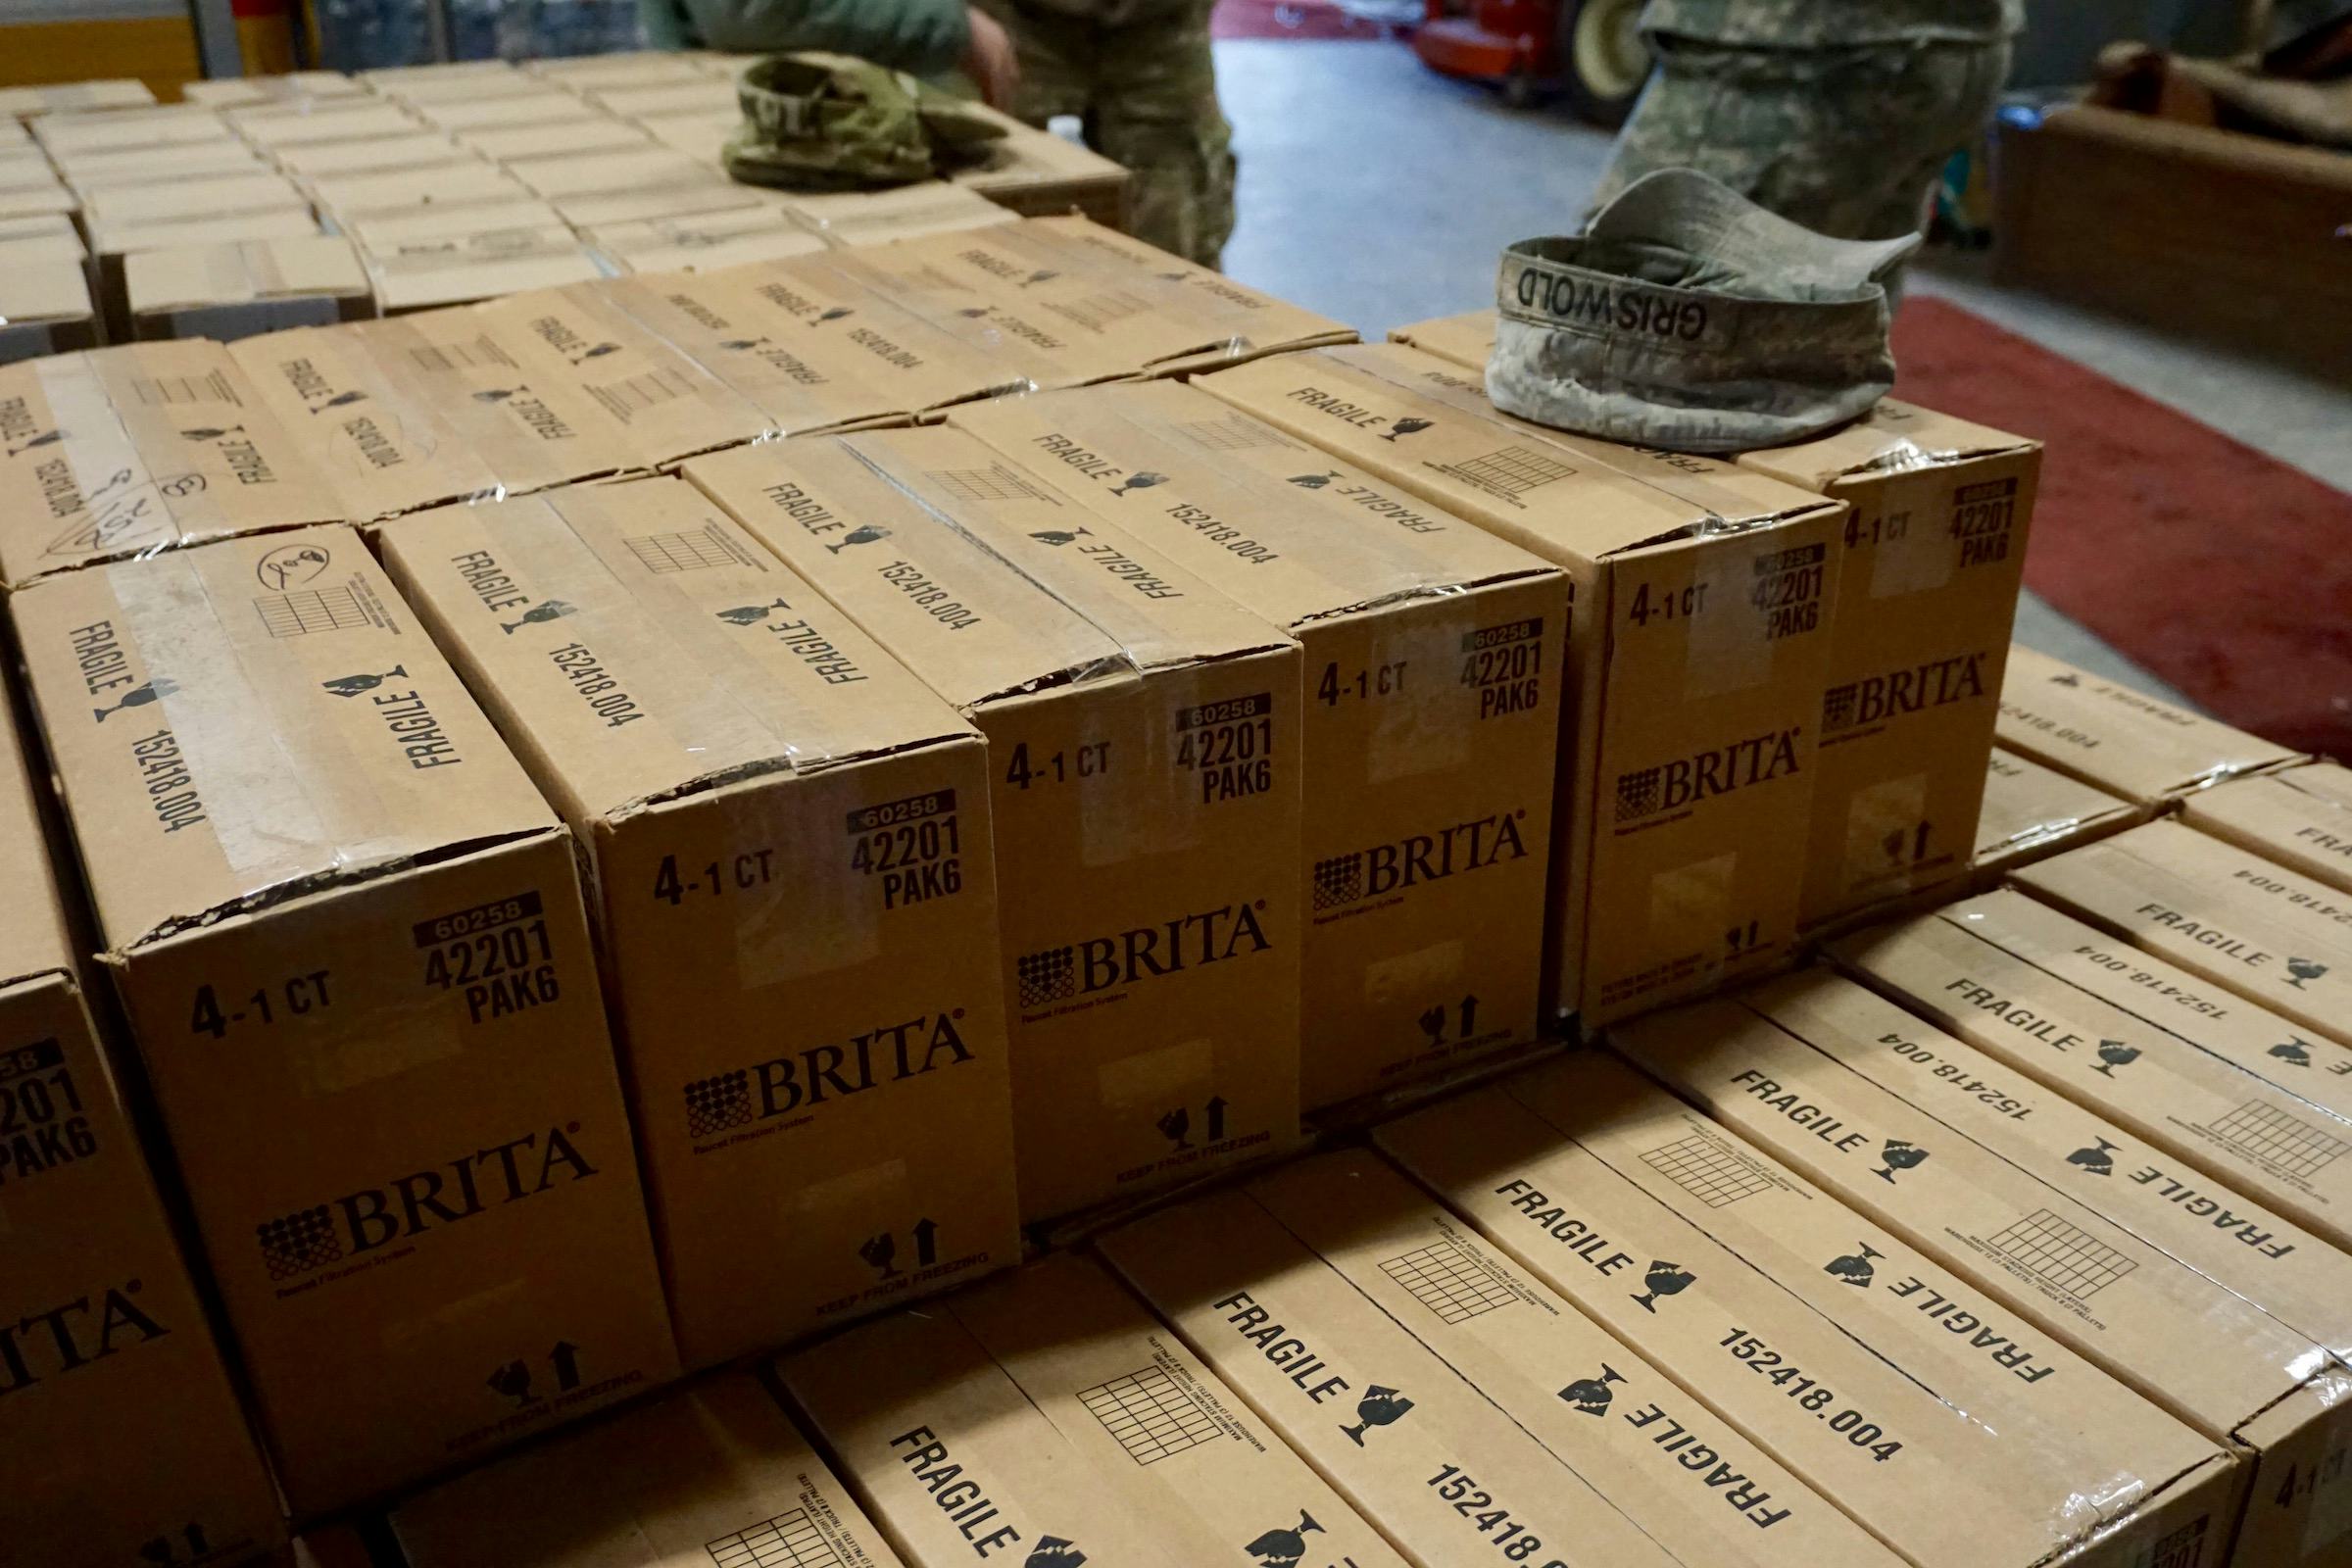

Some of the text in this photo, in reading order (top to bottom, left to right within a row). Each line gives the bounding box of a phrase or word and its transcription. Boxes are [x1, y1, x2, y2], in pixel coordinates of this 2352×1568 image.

[1517, 267, 1707, 342] GRISWOLD
[1286, 387, 1387, 429] FRAGILE
[1032, 432, 1124, 480] FRAGILE
[762, 481, 846, 536] FRAGILE
[1165, 503, 1278, 565] 152418.004
[1335, 485, 1447, 534] FRAGILE
[451, 549, 529, 612] FRAGILE
[877, 560, 982, 632] 152418.004
[1077, 542, 1185, 600] FRAGILE
[1682, 583, 1708, 616] CT
[1752, 564, 1823, 612] 42201
[766, 619, 870, 685] FRAGILE
[1766, 602, 1819, 640] PAK6
[69, 619, 134, 695] FRAGILE
[548, 642, 645, 727] 152418.004
[1378, 661, 1406, 696] CT
[1460, 641, 1542, 688] 42201
[371, 690, 463, 769] FRAGILE
[1192, 699, 1255, 726] 60258
[1481, 678, 1539, 720] PAK6
[1078, 741, 1110, 777] CT
[1176, 718, 1271, 770] 42201
[131, 729, 206, 835] 152418.004
[866, 797, 939, 827] 60258
[1203, 759, 1271, 805] PAK6
[735, 848, 773, 889] CT
[851, 814, 959, 875] 42201
[883, 858, 961, 909] PAK6
[434, 901, 522, 940] 60258
[2135, 902, 2273, 968] FRAGILE
[424, 919, 554, 992] 42201
[2073, 945, 2230, 1022] 152418.004
[285, 970, 330, 1015] CT
[465, 965, 560, 1025] PAK6
[1943, 977, 2084, 1054] FRAGILE
[0, 1068, 82, 1137] 201
[1878, 1032, 2034, 1122] 152418.004
[1731, 1069, 1870, 1153] FRAGILE
[1494, 1178, 1634, 1277] FRAGILE
[2128, 1166, 2296, 1259] FRAGILE
[1213, 1291, 1350, 1404] FRAGILE
[1887, 1276, 2055, 1385] FRAGILE
[1719, 1327, 1903, 1464] 152418.004
[889, 1425, 1021, 1558] FRAGILE
[1623, 1402, 1792, 1529] FRAGILE
